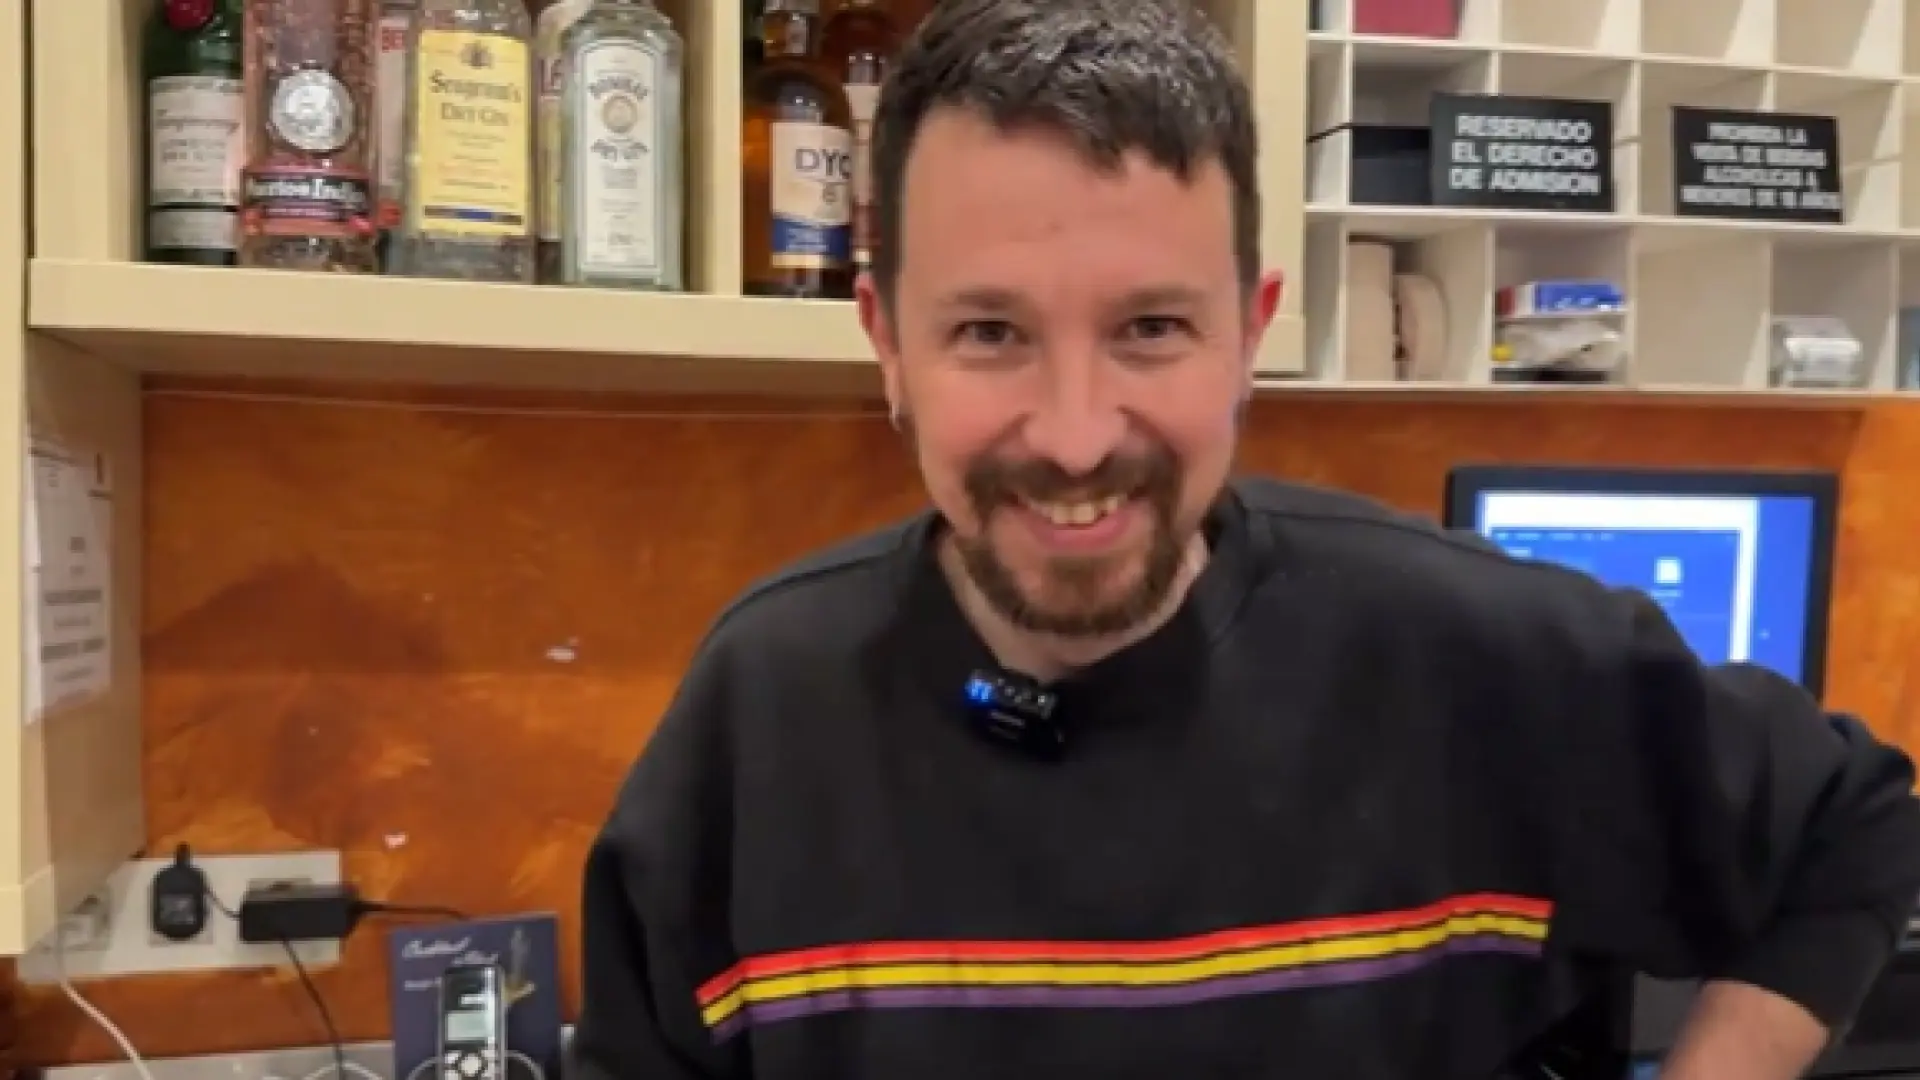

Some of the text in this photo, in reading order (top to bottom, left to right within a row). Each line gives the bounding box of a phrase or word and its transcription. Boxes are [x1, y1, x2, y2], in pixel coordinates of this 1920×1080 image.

[430, 69, 520, 103] Seagram's
[1456, 114, 1592, 142] RESERVADO
[1786, 127, 1807, 145] LA
[795, 148, 850, 178] DYC
[1451, 141, 1597, 168] EL DERECHO
[1449, 168, 1601, 195] DE ADMISION
